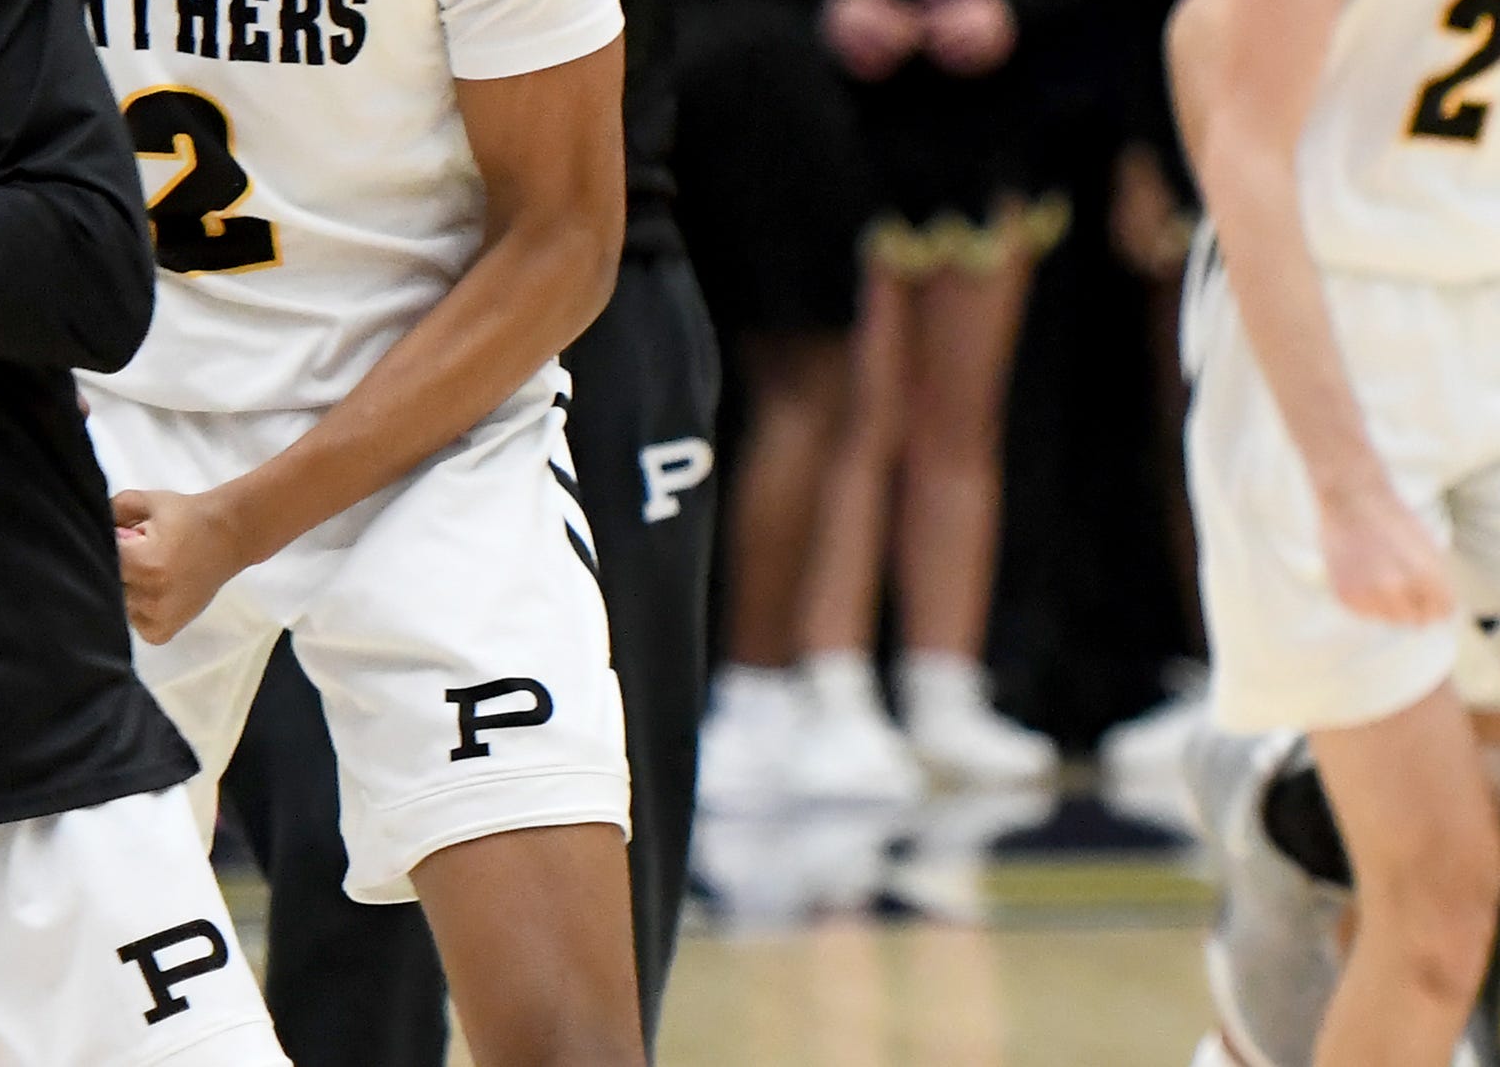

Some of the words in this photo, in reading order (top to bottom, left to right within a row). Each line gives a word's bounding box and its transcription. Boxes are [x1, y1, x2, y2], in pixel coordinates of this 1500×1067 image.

[638, 435, 716, 525] P
[444, 676, 555, 763] P
[116, 917, 230, 1027] P
